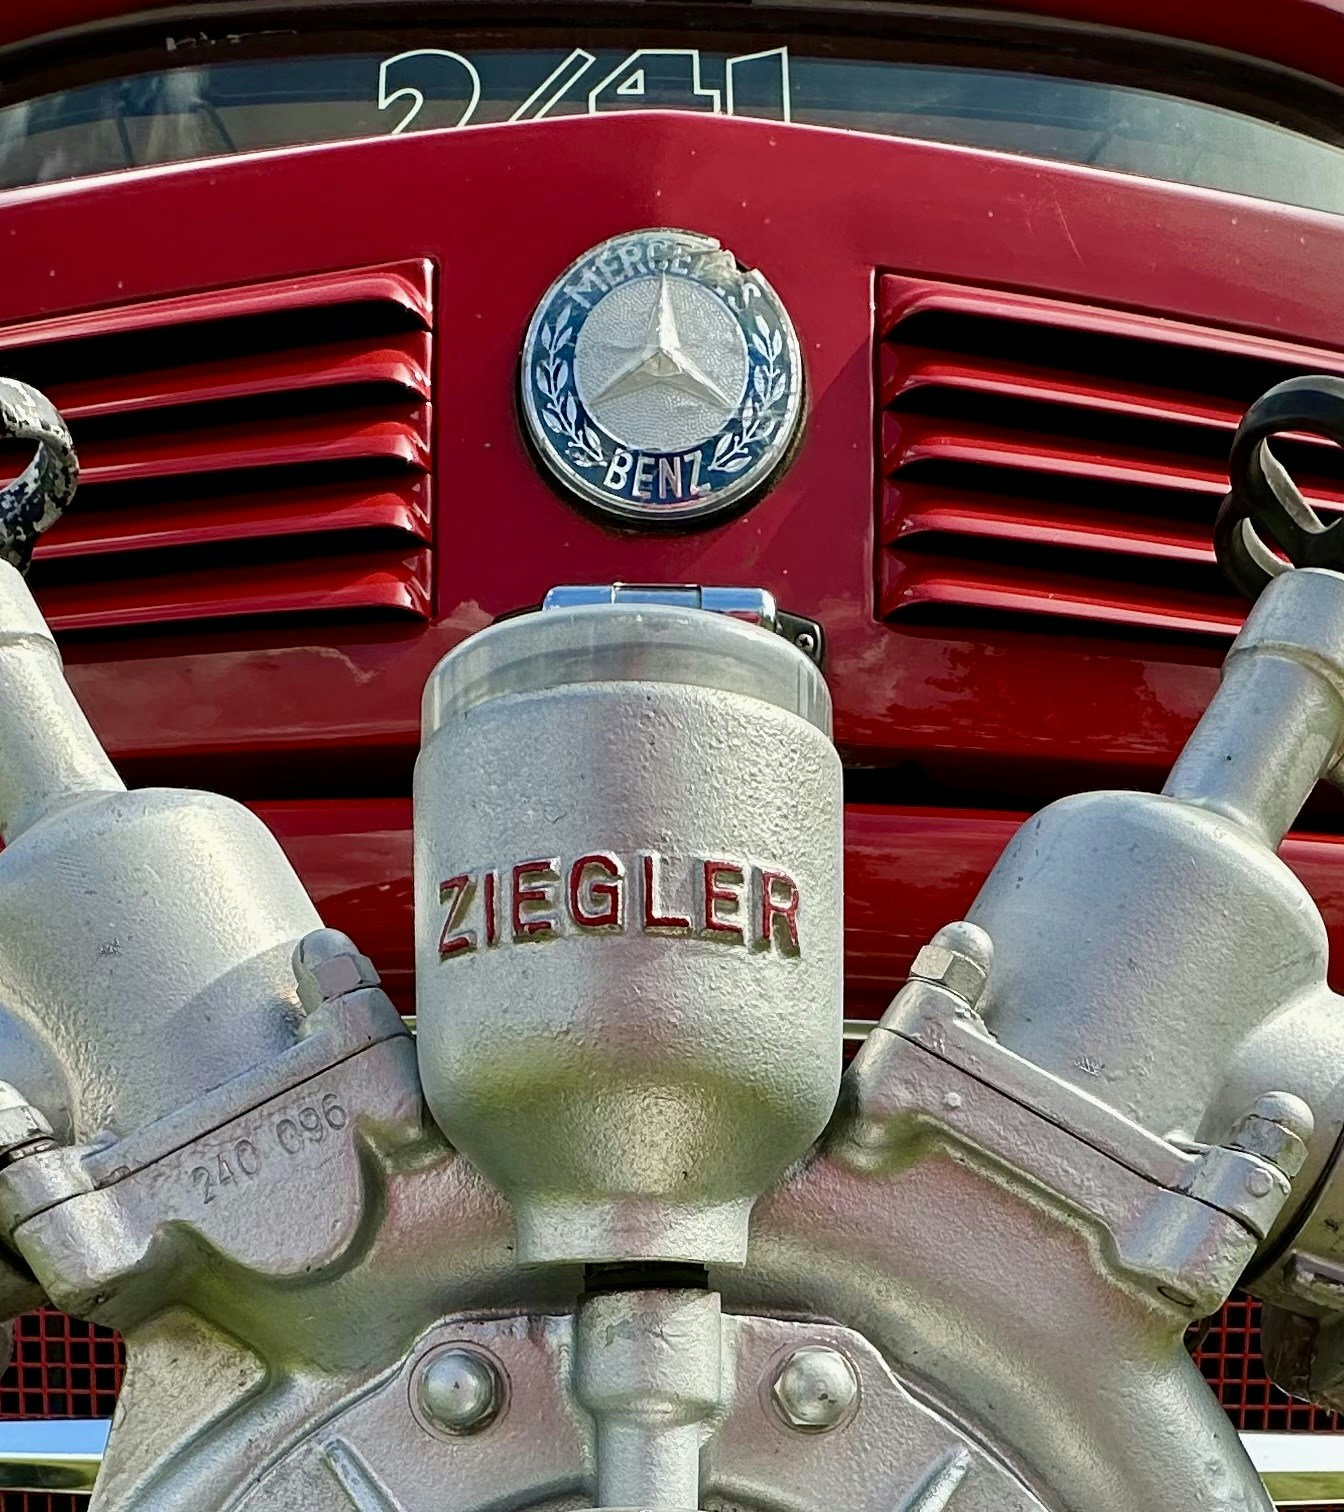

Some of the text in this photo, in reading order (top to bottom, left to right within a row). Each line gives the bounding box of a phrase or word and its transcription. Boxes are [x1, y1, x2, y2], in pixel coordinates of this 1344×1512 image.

[561, 239, 762, 311] MERCES
[602, 449, 712, 500] BENZ
[438, 850, 802, 960] ZIEGLER
[190, 1093, 348, 1205] 240 096
